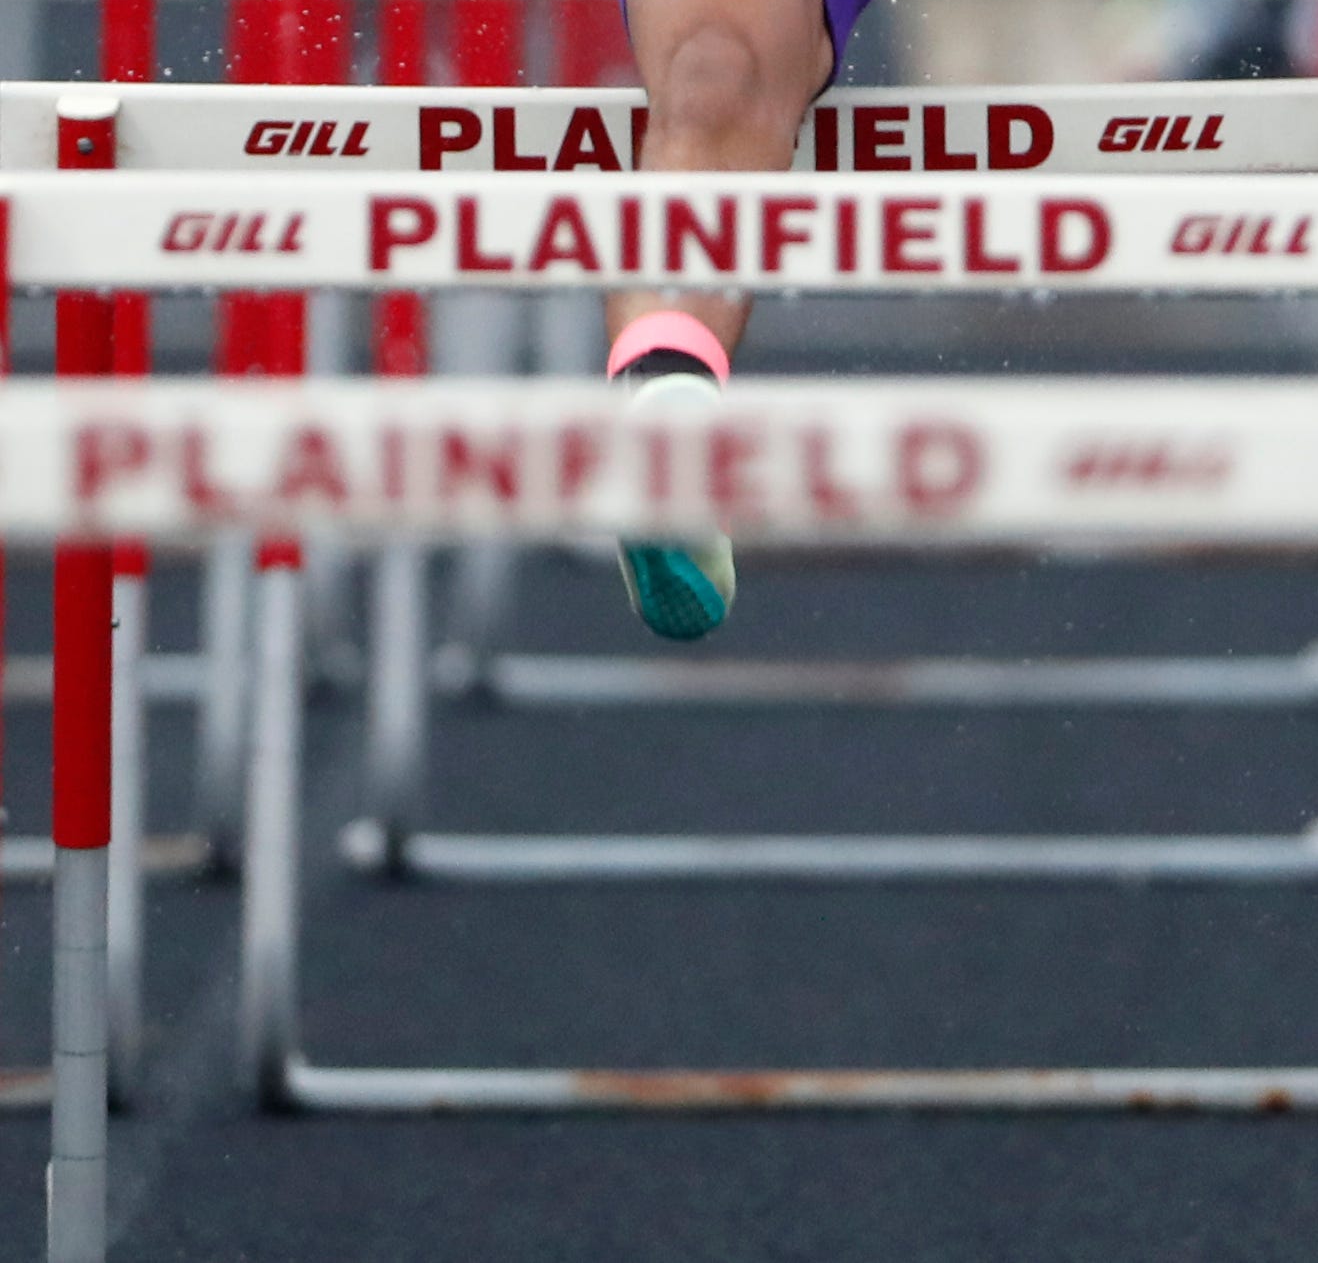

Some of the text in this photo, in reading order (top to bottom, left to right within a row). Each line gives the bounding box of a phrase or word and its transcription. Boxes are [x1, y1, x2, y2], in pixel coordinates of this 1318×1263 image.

[245, 104, 1223, 172] GILL PLAIIELD GILL
[161, 195, 1310, 276] GILL PLAINFIELD GILL
[70, 421, 983, 516] PLAINFIELD
